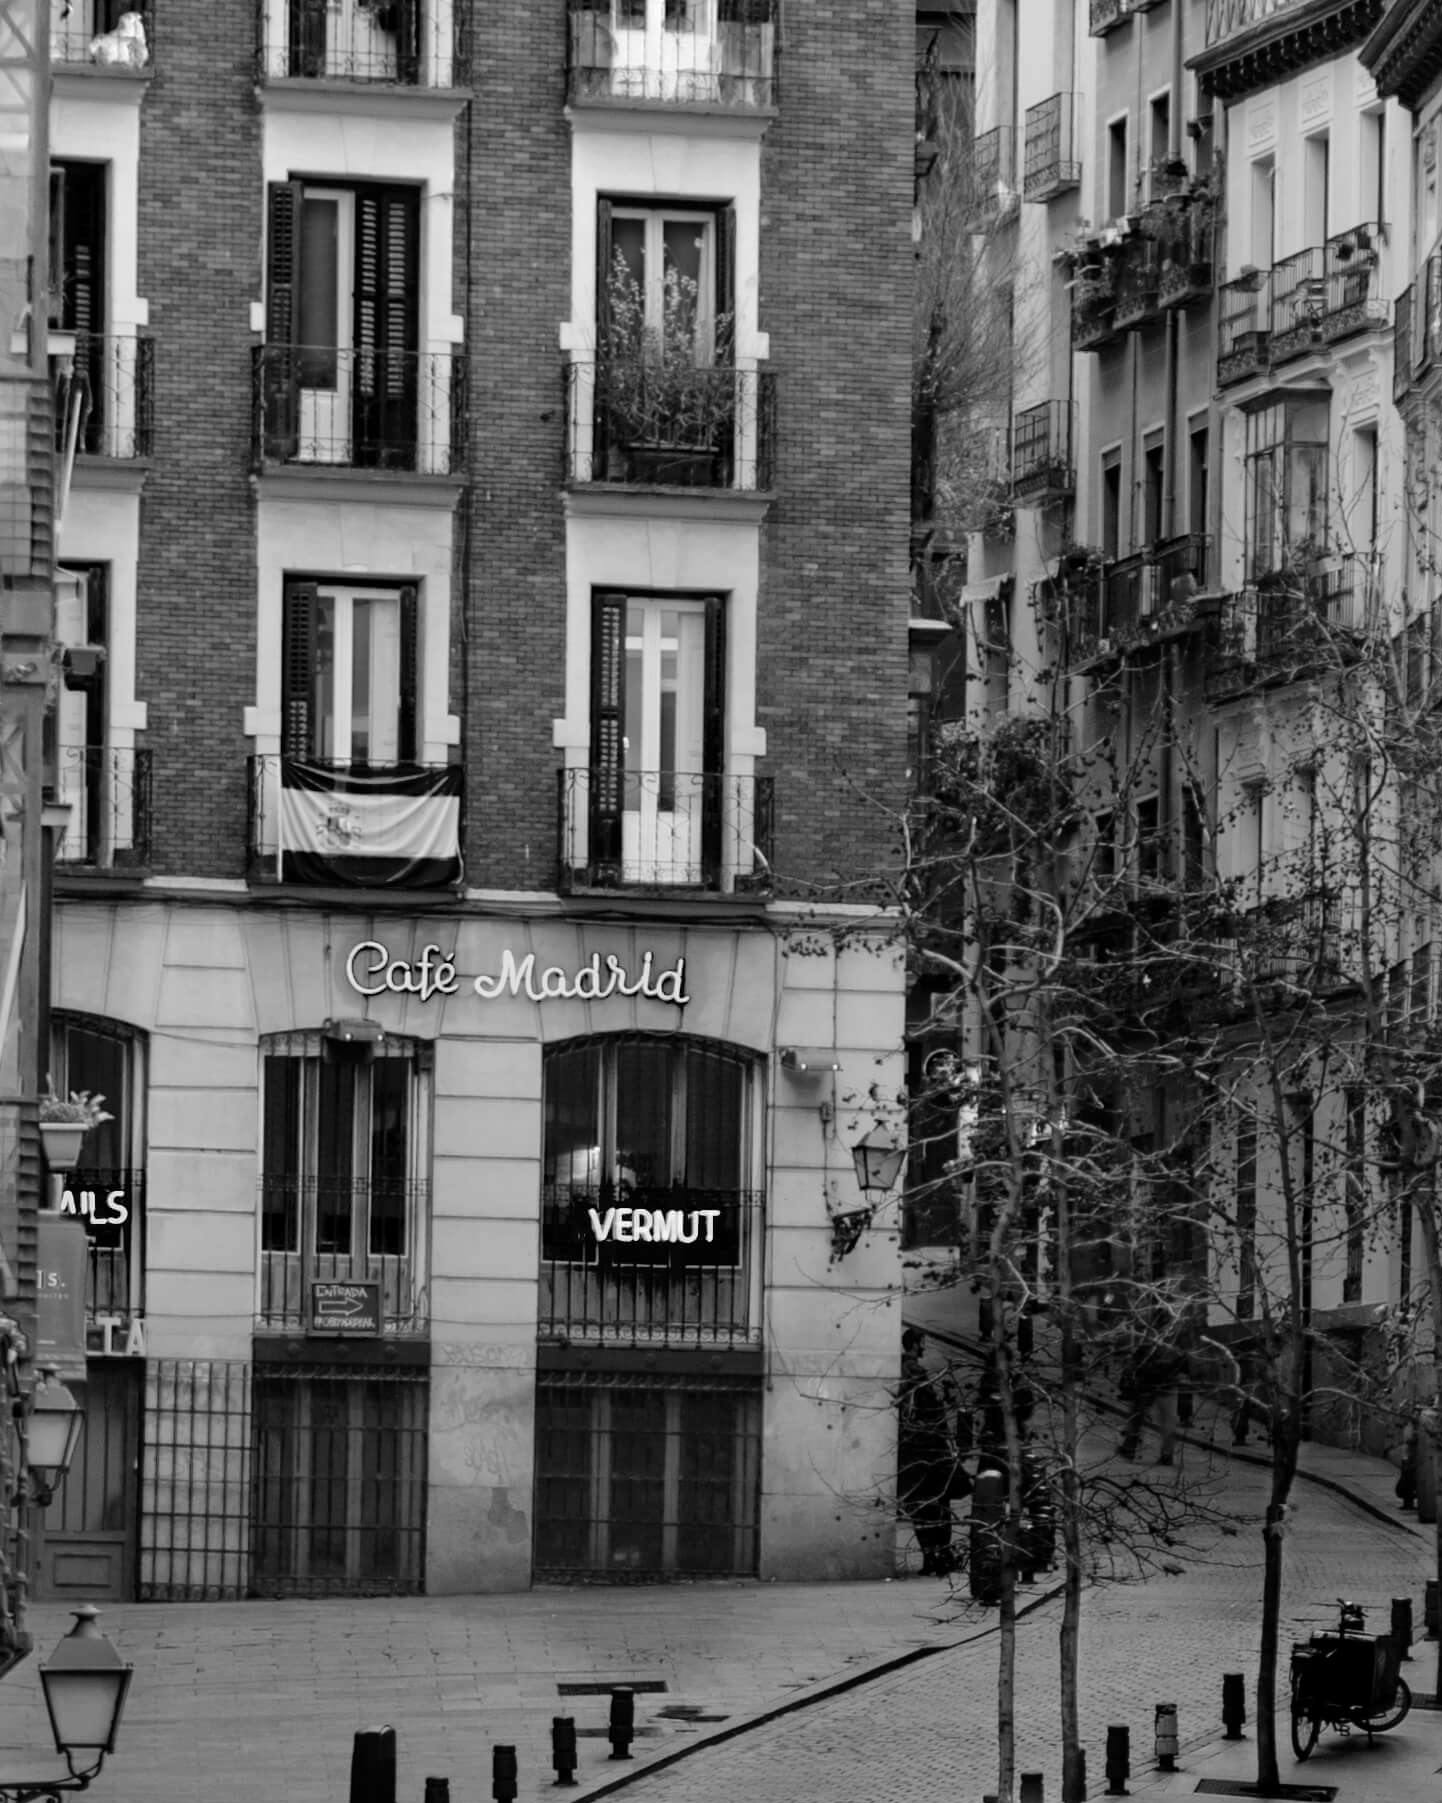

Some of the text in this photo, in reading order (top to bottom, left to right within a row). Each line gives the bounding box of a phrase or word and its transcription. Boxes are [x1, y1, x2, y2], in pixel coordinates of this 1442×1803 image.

[347, 941, 689, 1004] Café Madrid
[588, 1208, 720, 1243] VERMUT
